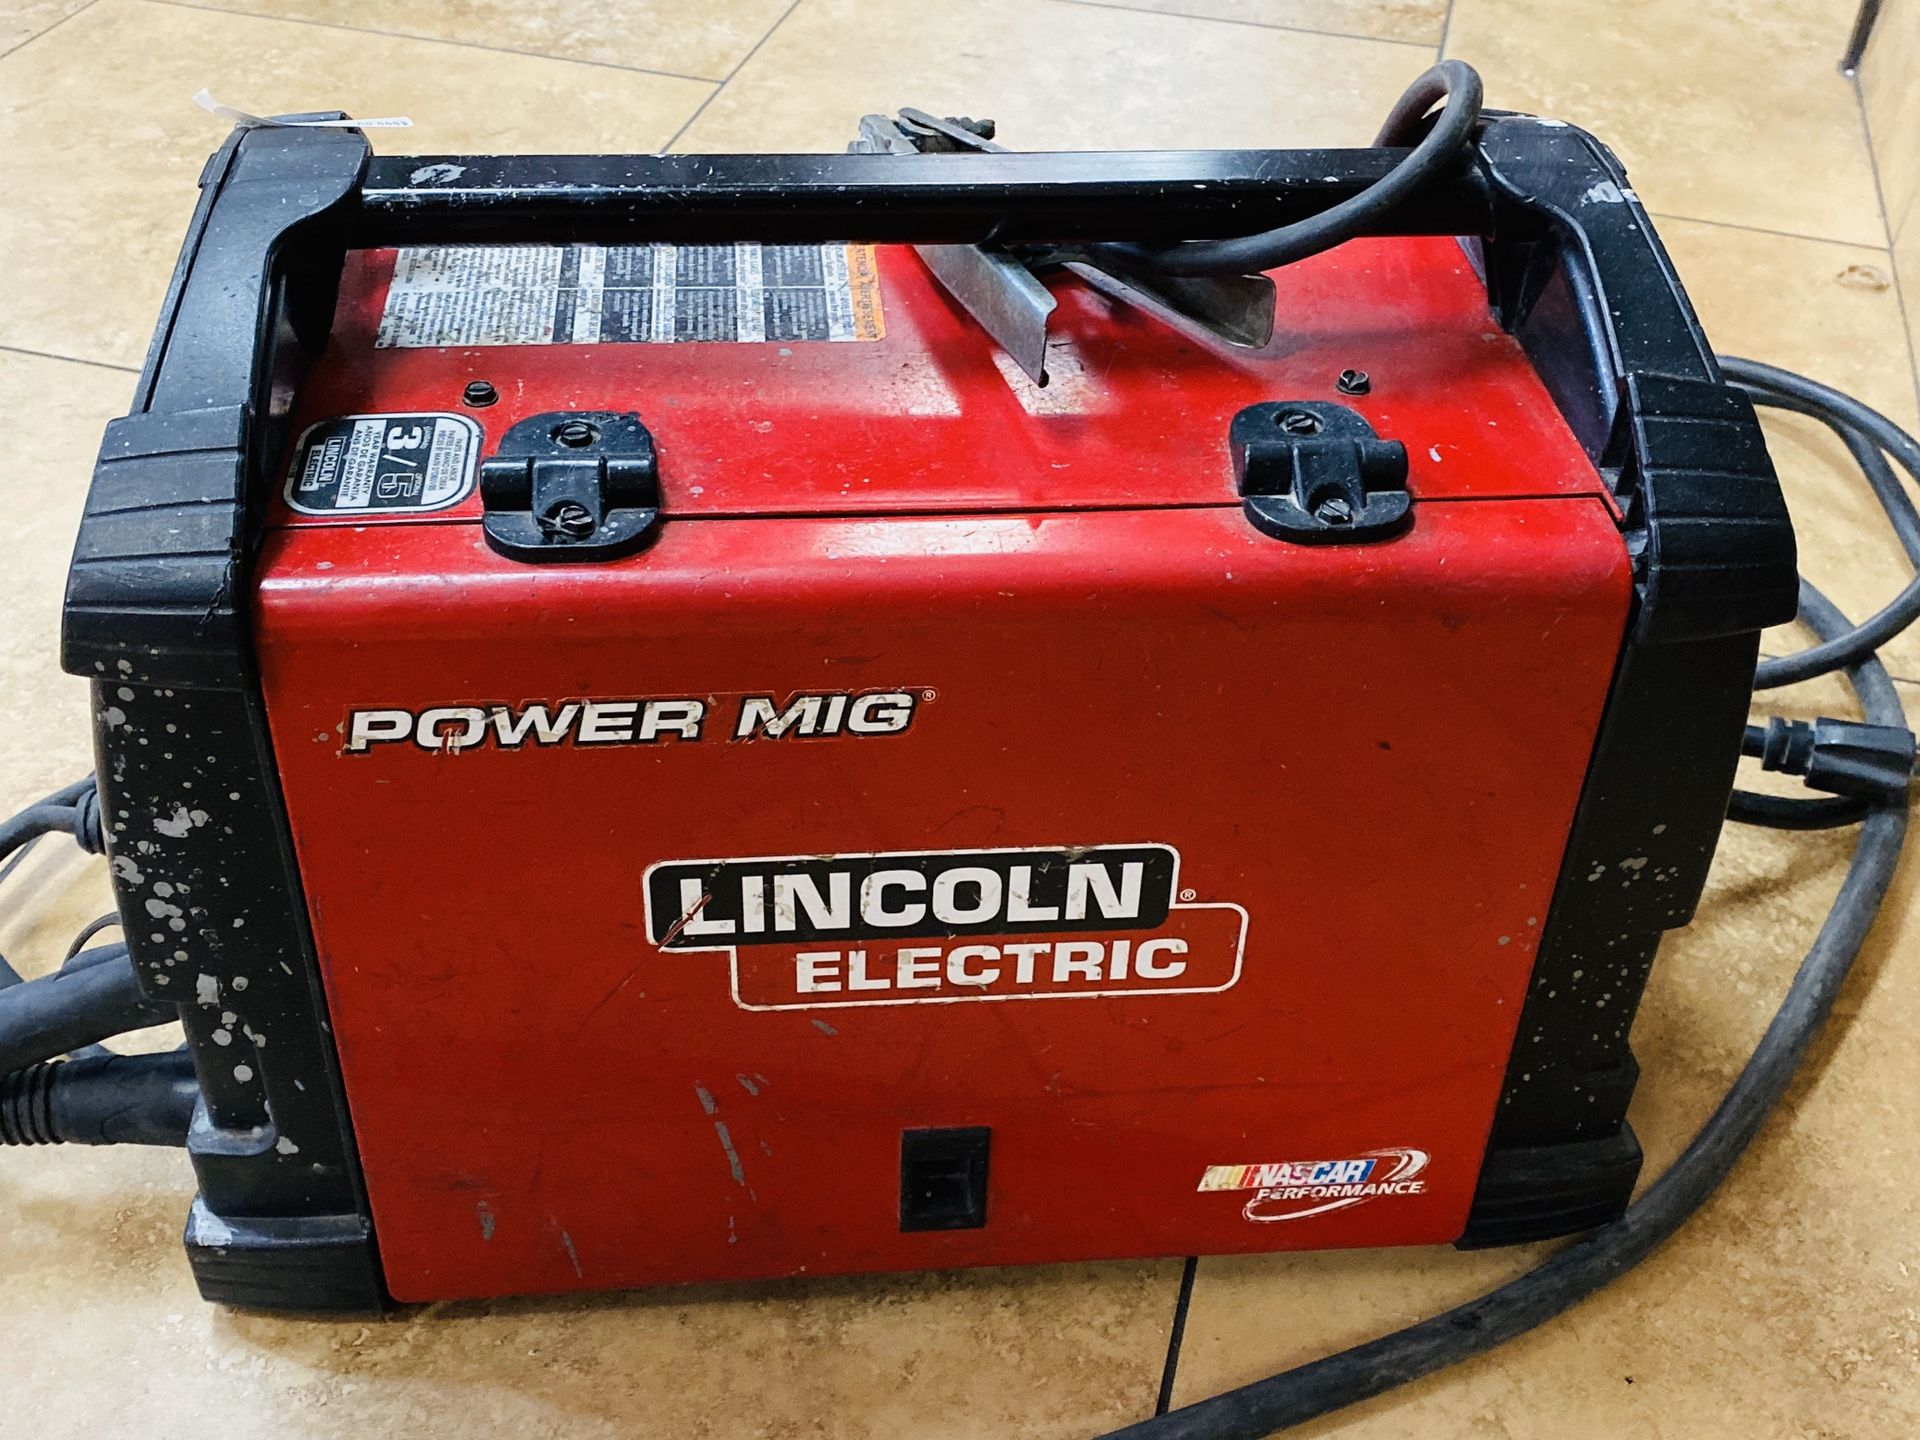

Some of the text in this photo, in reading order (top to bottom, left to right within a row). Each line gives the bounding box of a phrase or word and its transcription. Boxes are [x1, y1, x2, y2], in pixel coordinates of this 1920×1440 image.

[318, 439, 342, 482] LINCOLN
[359, 448, 368, 459] DE
[432, 452, 442, 466] MAIN
[442, 451, 452, 467] MANO
[453, 438, 463, 453] PARTS
[303, 449, 321, 487] ELECTRIC
[339, 429, 363, 497] ANS DE GARANTIE
[362, 431, 382, 495] YEAR WARRANTY
[448, 465, 458, 482] LABOR
[347, 692, 914, 752] POWER MIG
[679, 861, 1145, 936] LINCOLN
[796, 938, 1190, 994] ELECTRIC
[1253, 1159, 1369, 1187] NASCAR
[1255, 1180, 1424, 1201] PERFORMANCE
